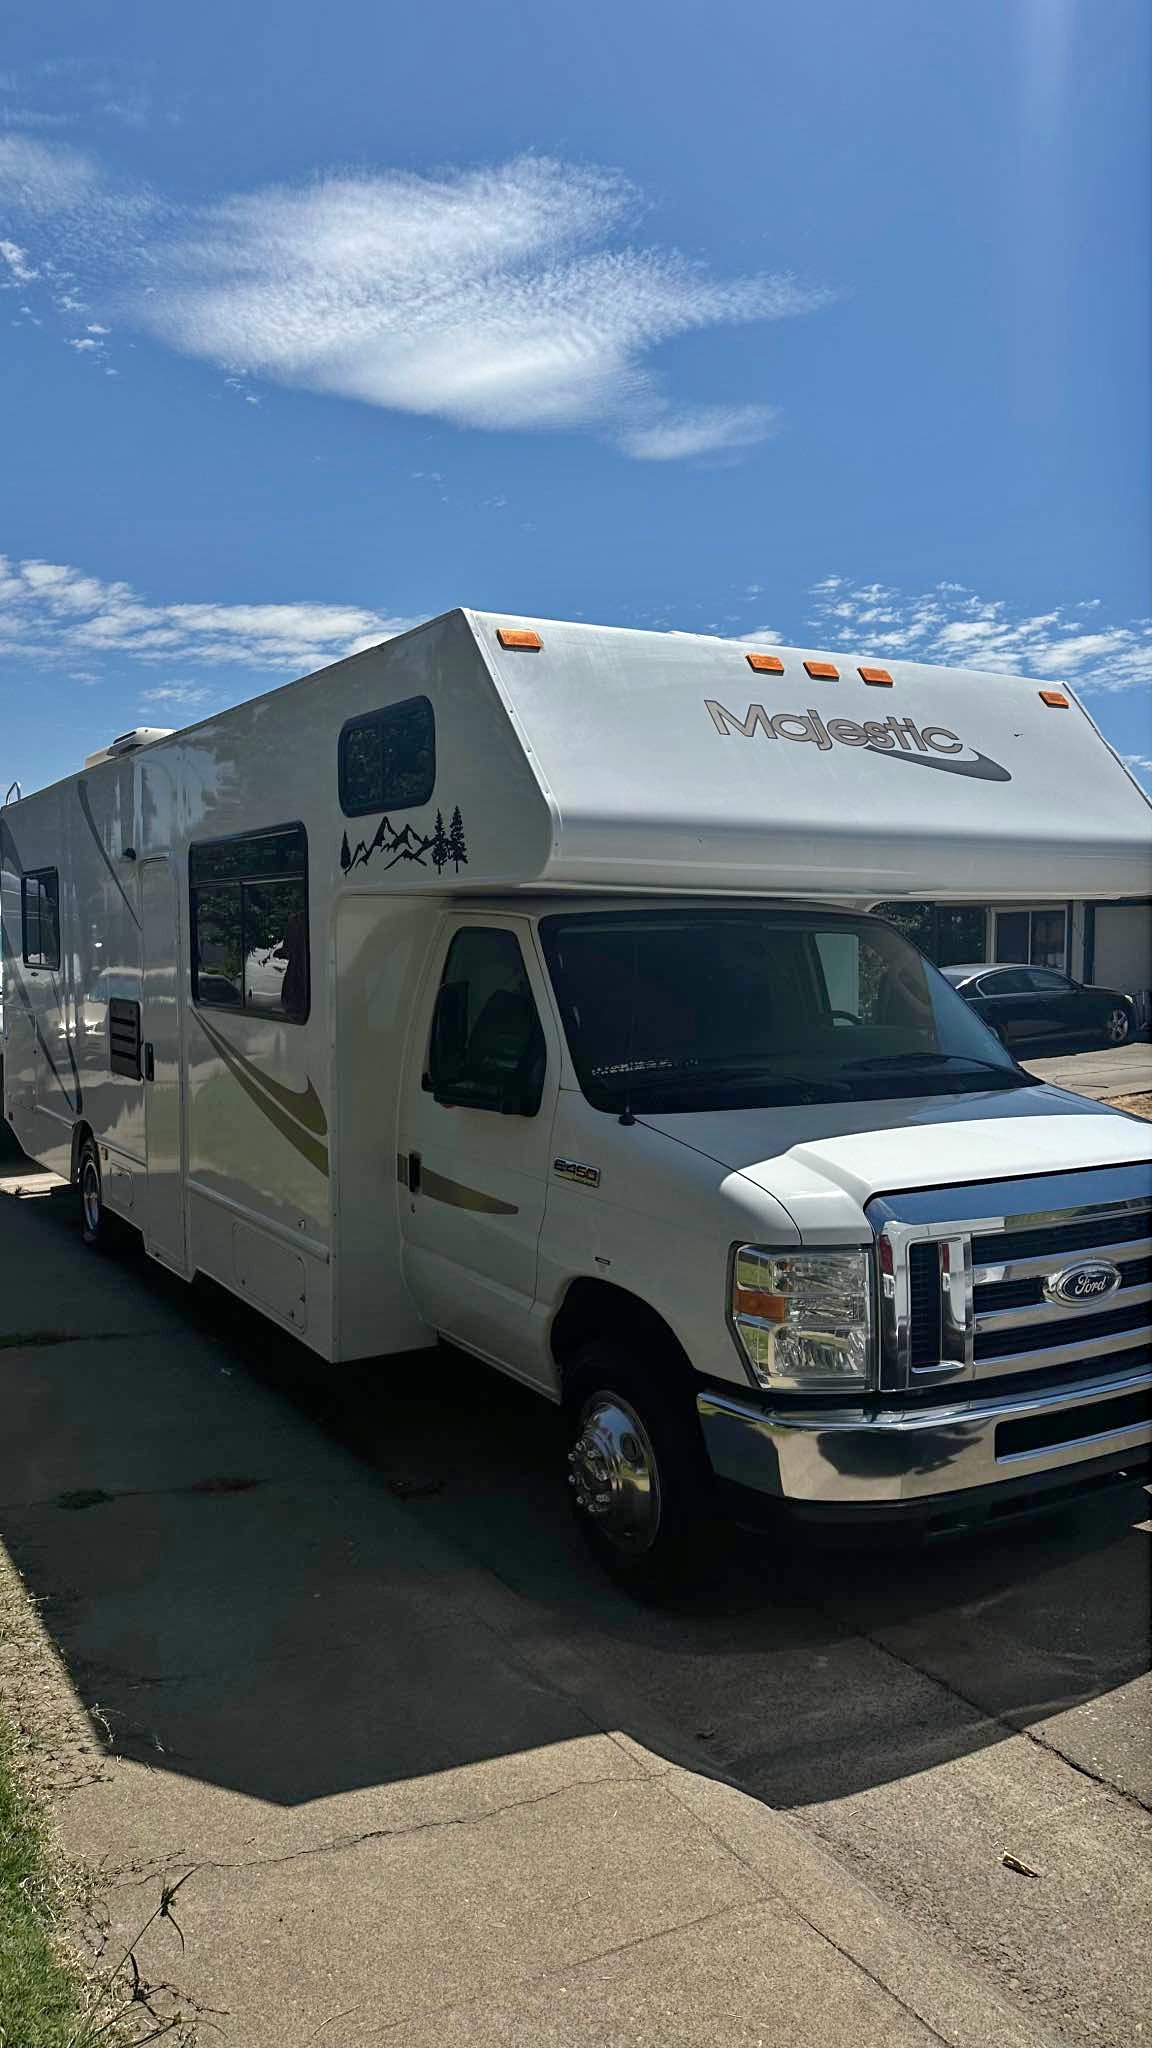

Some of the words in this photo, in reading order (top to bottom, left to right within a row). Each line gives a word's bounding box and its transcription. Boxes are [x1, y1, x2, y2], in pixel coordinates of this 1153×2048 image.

[703, 699, 963, 754] Majestic
[554, 1158, 598, 1182] E450
[1074, 1272, 1107, 1295] Ford
